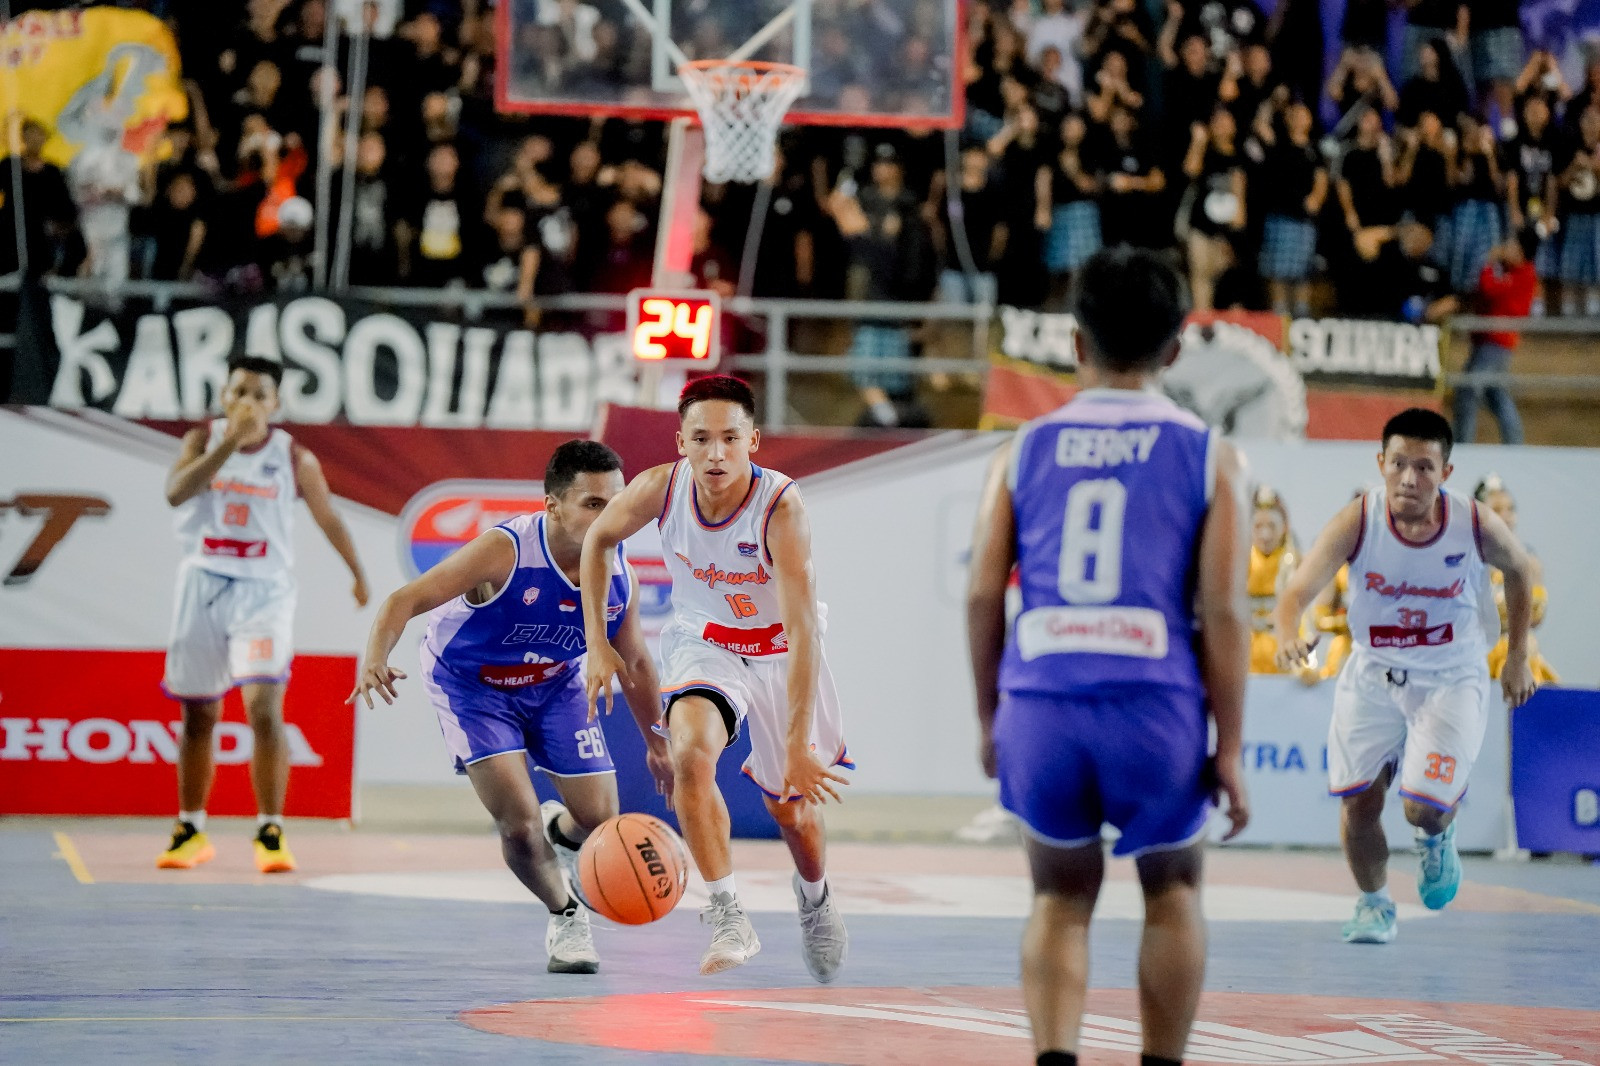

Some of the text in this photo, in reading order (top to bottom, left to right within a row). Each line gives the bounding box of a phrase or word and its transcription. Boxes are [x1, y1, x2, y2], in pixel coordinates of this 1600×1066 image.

[634, 299, 713, 359] 24
[724, 594, 758, 619] 16
[574, 726, 605, 759] 26
[1424, 752, 1456, 785] 33
[635, 837, 667, 877] DBL
